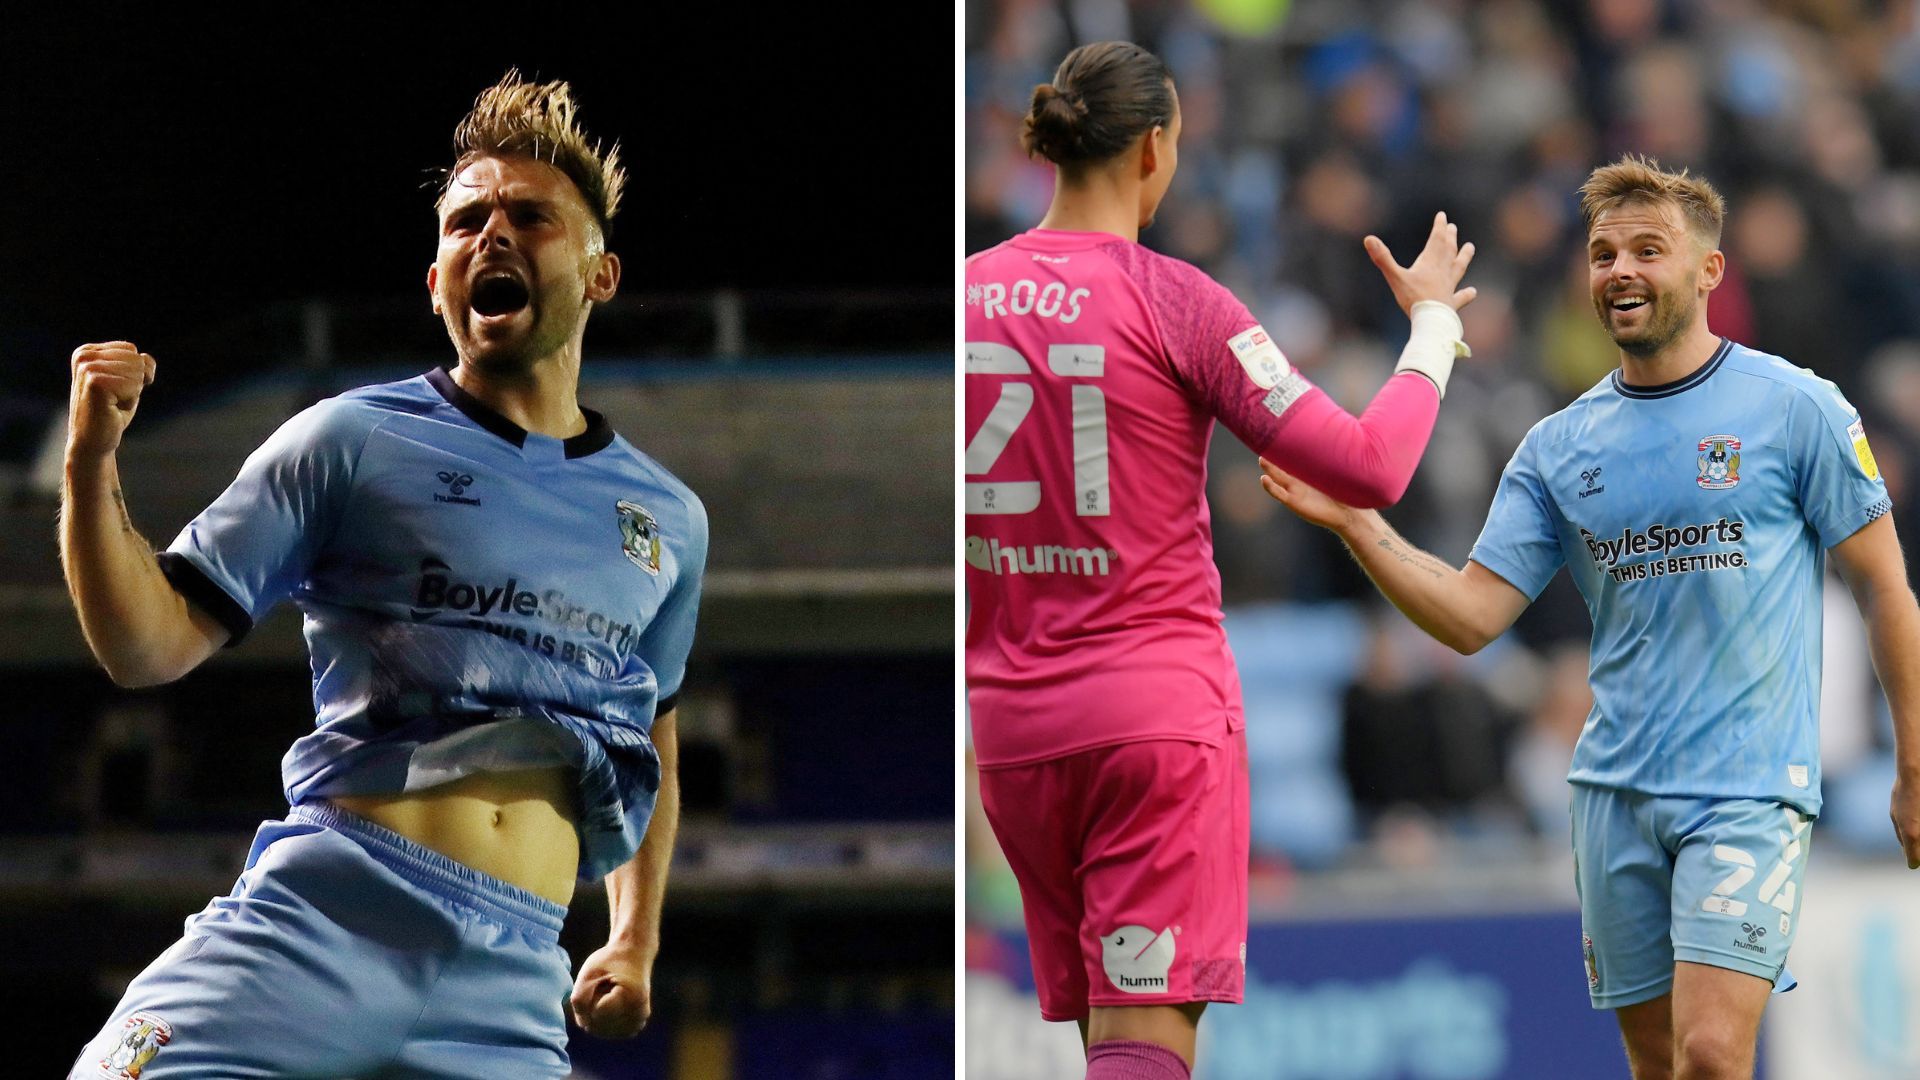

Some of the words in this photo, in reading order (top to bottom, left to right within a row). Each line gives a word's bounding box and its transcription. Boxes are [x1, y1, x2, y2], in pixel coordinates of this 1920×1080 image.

[984, 279, 1090, 324] ROOS
[965, 341, 1111, 516] 21
[1579, 485, 1605, 499] hummel
[990, 537, 1109, 576] humm
[1586, 518, 1745, 567] BoyleSports
[1609, 562, 1647, 583] THIS
[1650, 562, 1665, 577] IS
[1667, 552, 1749, 575] BETTING.
[413, 566, 640, 654] BoyleSport
[532, 632, 556, 657] IS
[1733, 939, 1768, 955] hummel
[1120, 974, 1164, 987] humm
